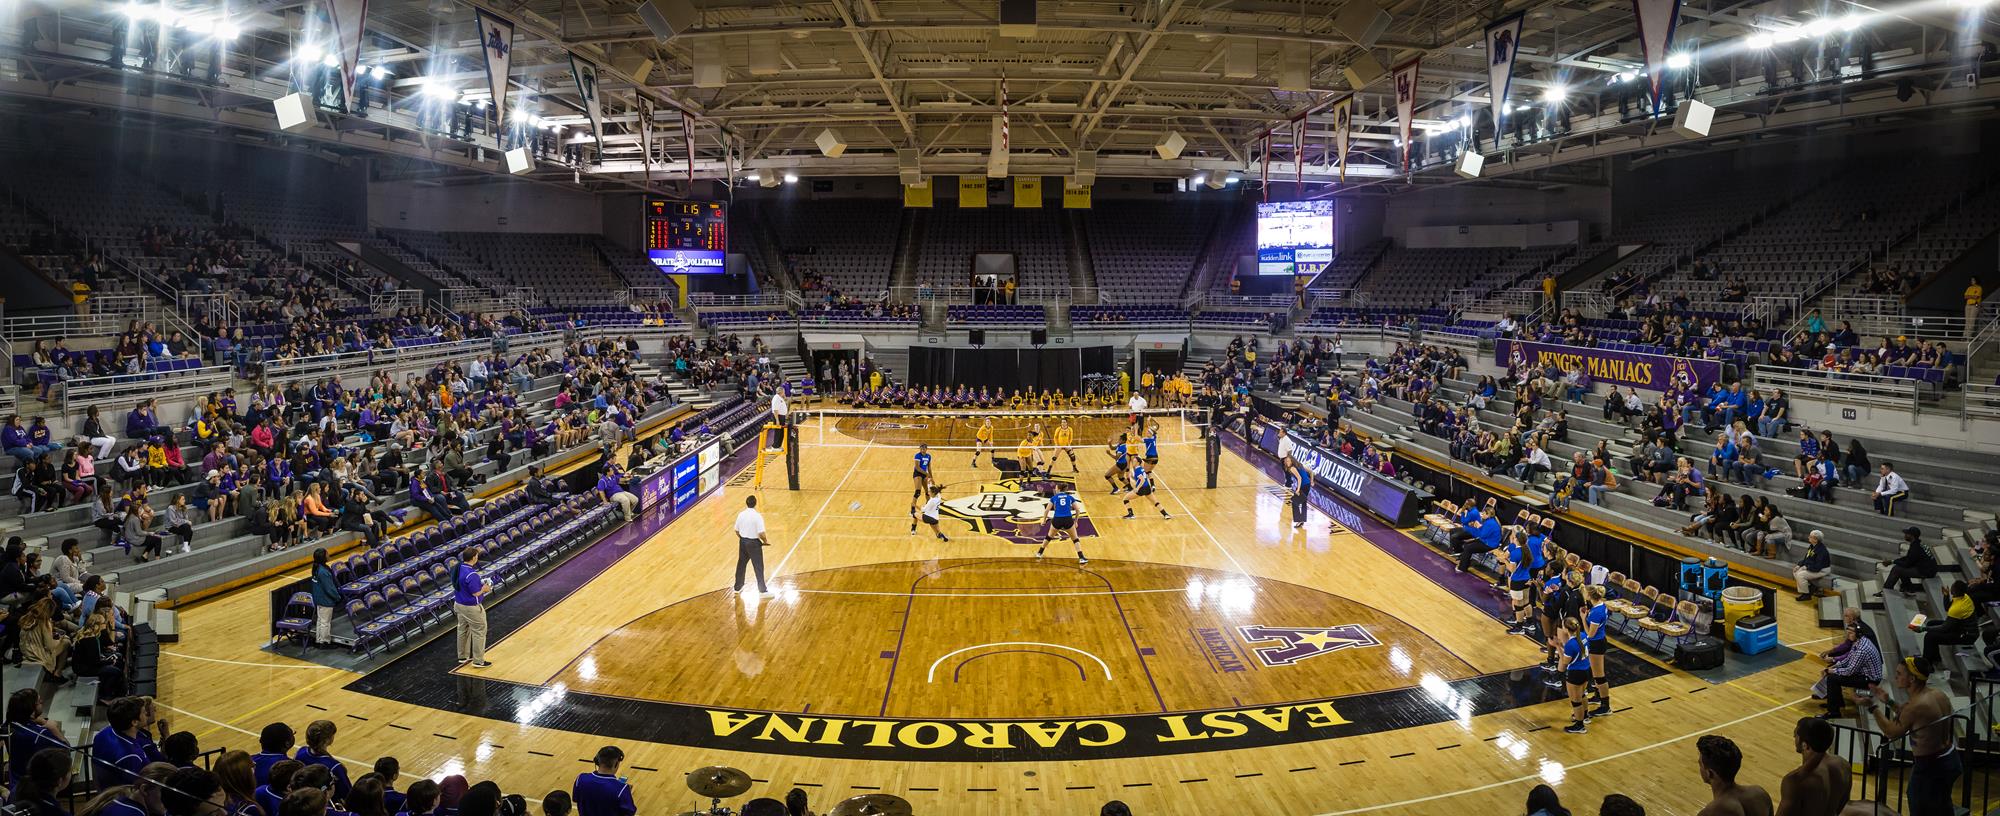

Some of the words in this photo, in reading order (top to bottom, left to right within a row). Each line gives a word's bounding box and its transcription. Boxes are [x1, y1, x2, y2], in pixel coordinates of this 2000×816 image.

[683, 204, 699, 215] 1:15
[697, 228, 702, 236] 2
[687, 258, 723, 266] VOLLEYBALL
[1588, 357, 1652, 385] MANIACS
[1844, 410, 1855, 418] 114
[1291, 442, 1308, 465] RATE
[1318, 457, 1365, 496] VOLLEYBALL
[1059, 498, 1067, 506] 6
[1197, 627, 1247, 673] AMERICAN
[705, 709, 1126, 749] CAROLINA
[1156, 701, 1354, 743] EAST
